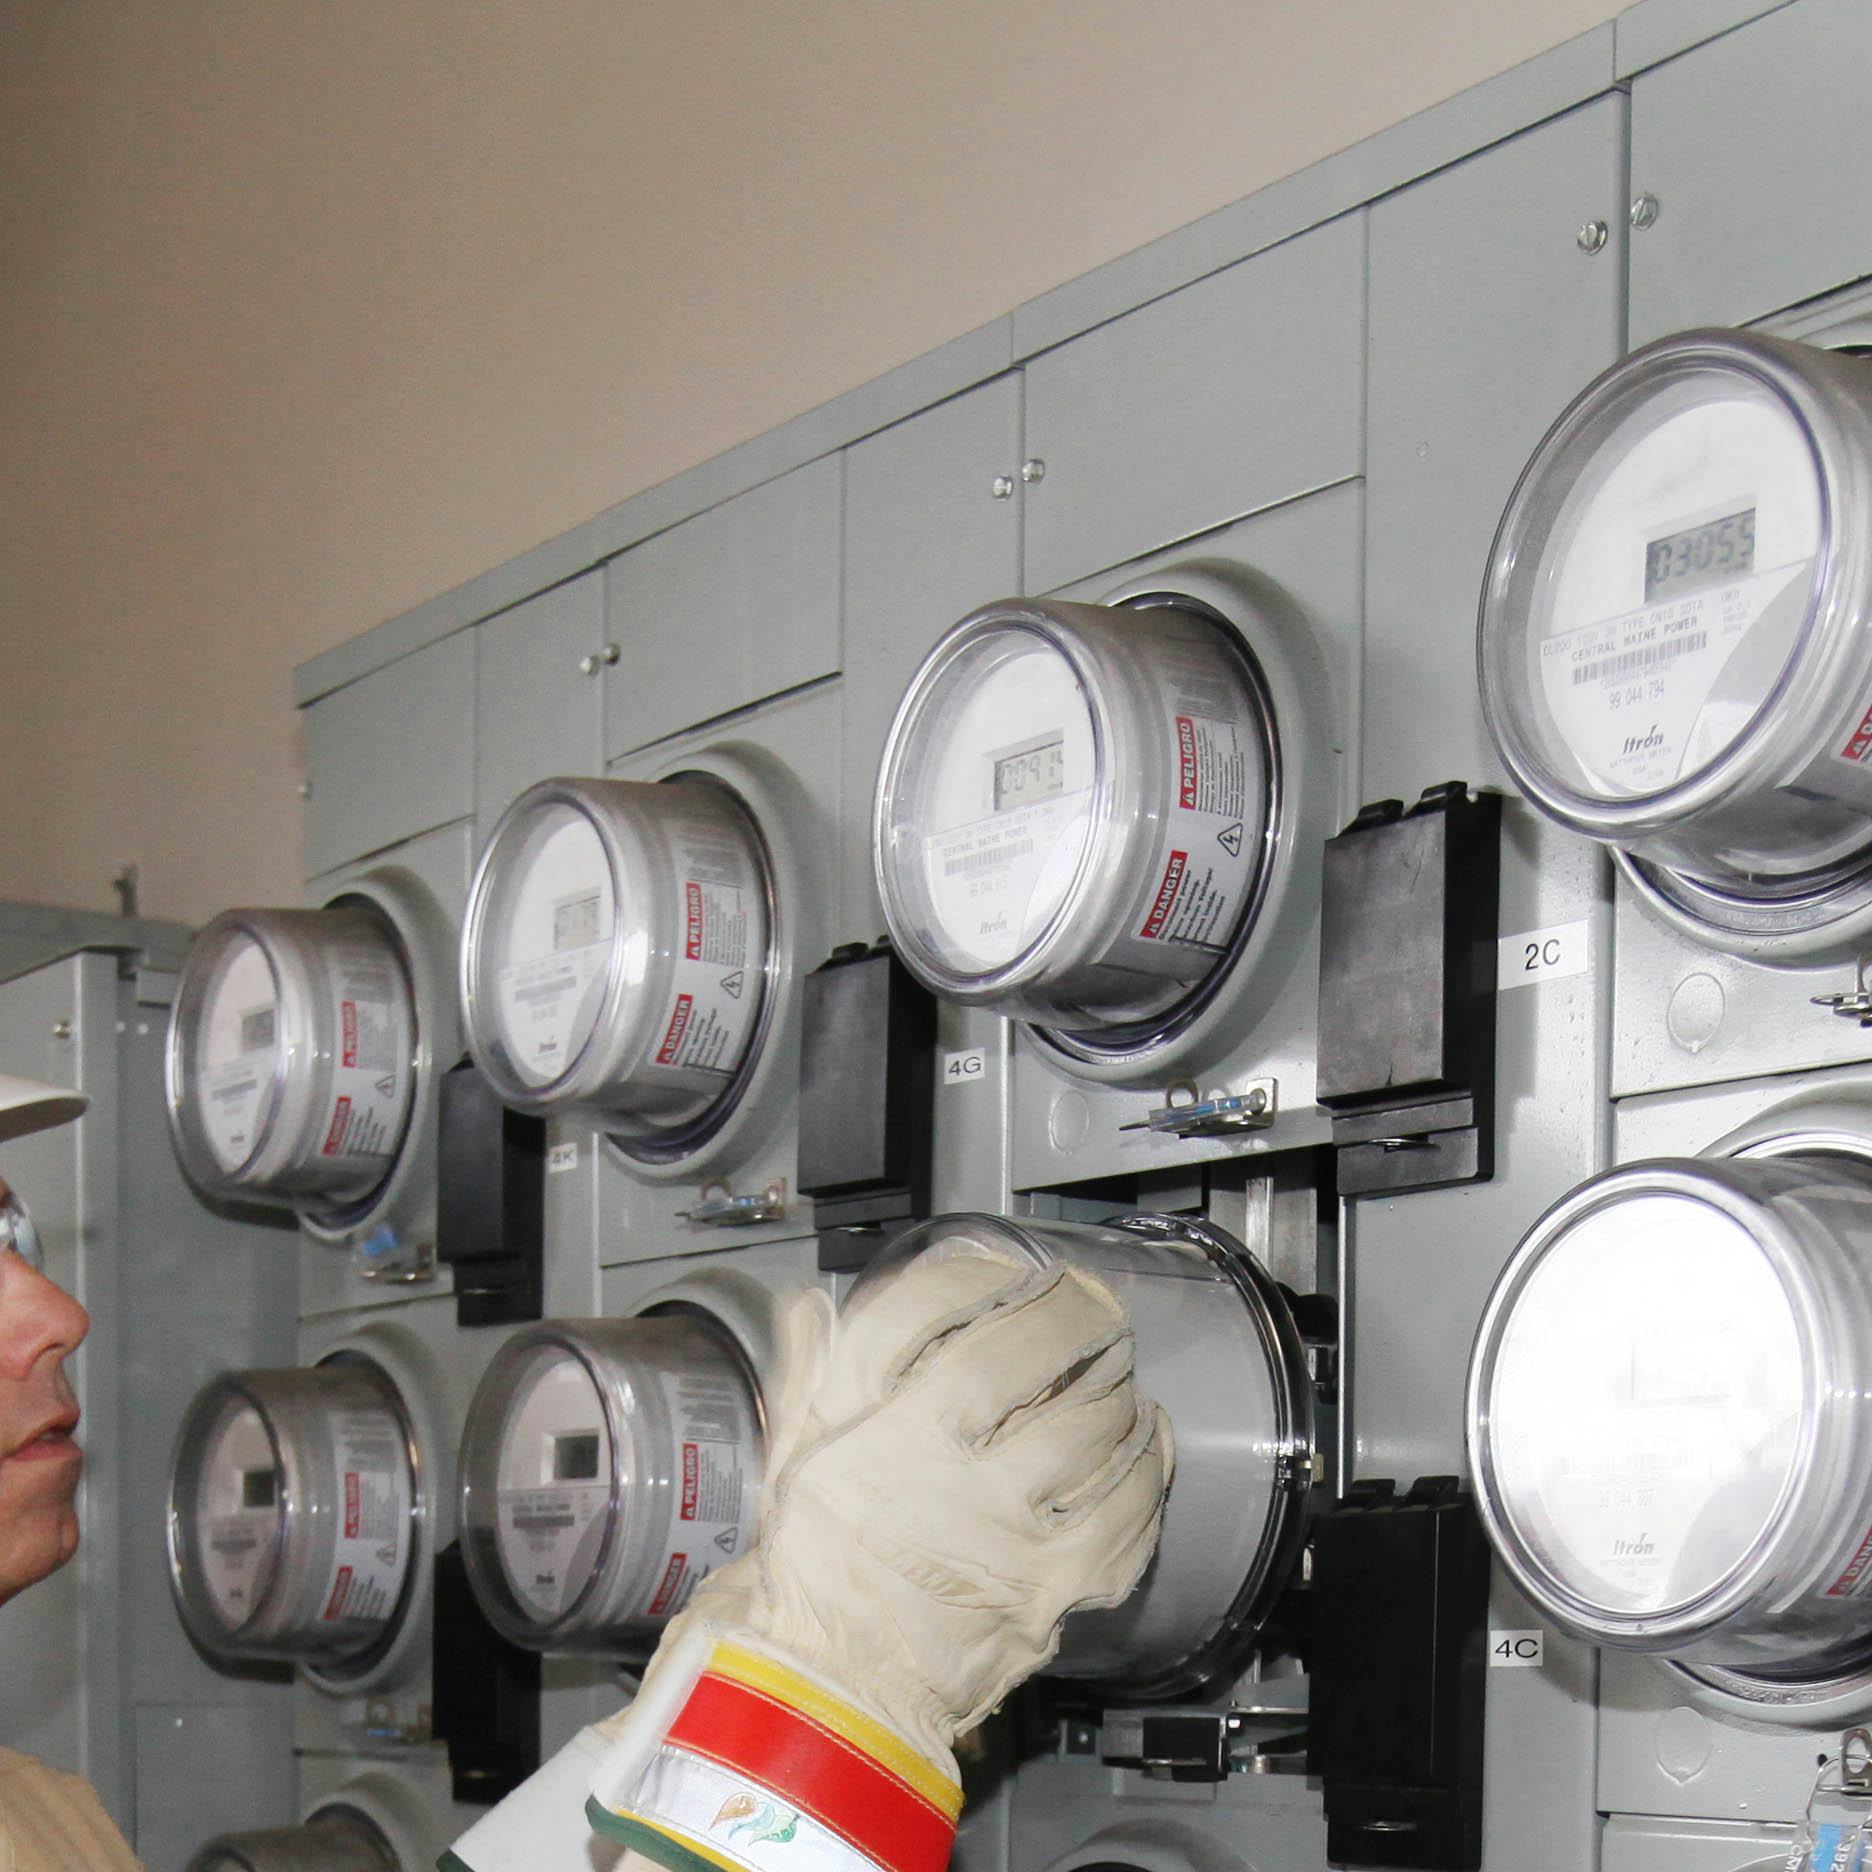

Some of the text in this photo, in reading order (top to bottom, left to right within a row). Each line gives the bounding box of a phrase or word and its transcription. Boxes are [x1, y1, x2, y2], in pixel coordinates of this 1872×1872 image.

[1571, 641, 1617, 662] CENTRAL
[1623, 628, 1657, 646] MAINE
[1663, 615, 1698, 635] POWER
[1181, 721, 1197, 789] PELIGRO
[1622, 723, 1664, 755] Itron
[1152, 857, 1185, 921] DANGER
[687, 886, 701, 946] PELIGRO
[1524, 938, 1561, 973] 2C
[666, 997, 692, 1052] DANGER
[947, 1056, 982, 1077] 4G
[551, 1147, 575, 1165] 4K
[686, 1447, 698, 1502] PELIGRO
[1613, 1531, 1655, 1556] Itron
[1495, 1638, 1539, 1660] 4C
